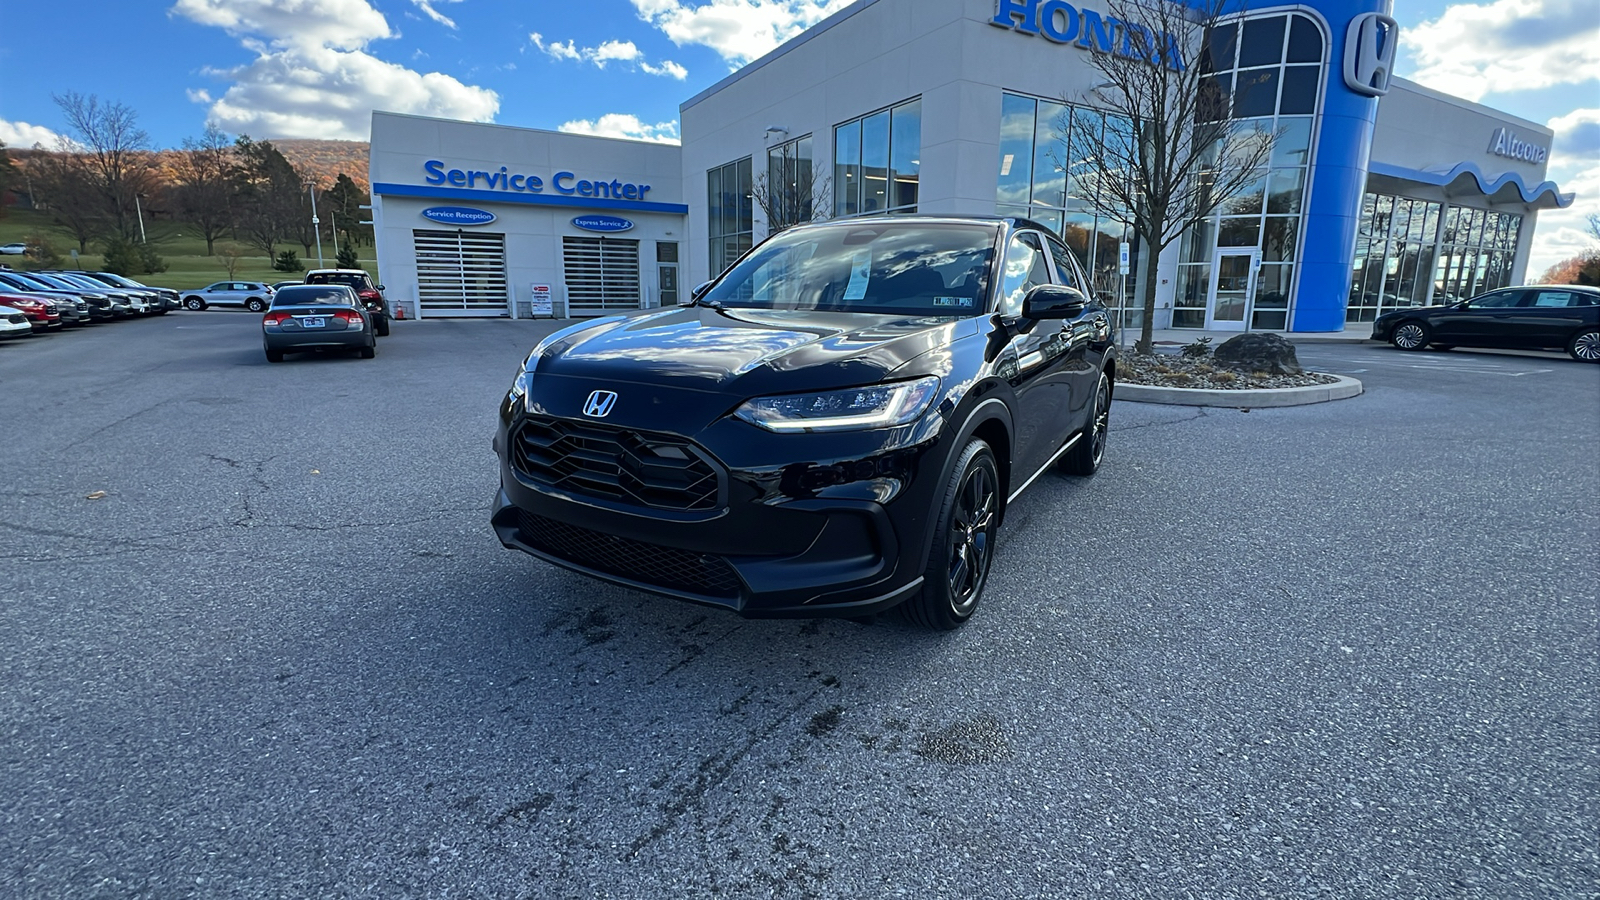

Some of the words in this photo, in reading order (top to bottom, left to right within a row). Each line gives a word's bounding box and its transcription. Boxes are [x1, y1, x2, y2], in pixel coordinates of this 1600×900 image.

[992, 0, 1187, 72] HONDA
[1494, 127, 1547, 164] Altoona
[424, 159, 544, 193] Service
[552, 171, 651, 200] Center
[426, 209, 455, 218] Service
[455, 211, 492, 221] Reception
[575, 218, 599, 226] Express
